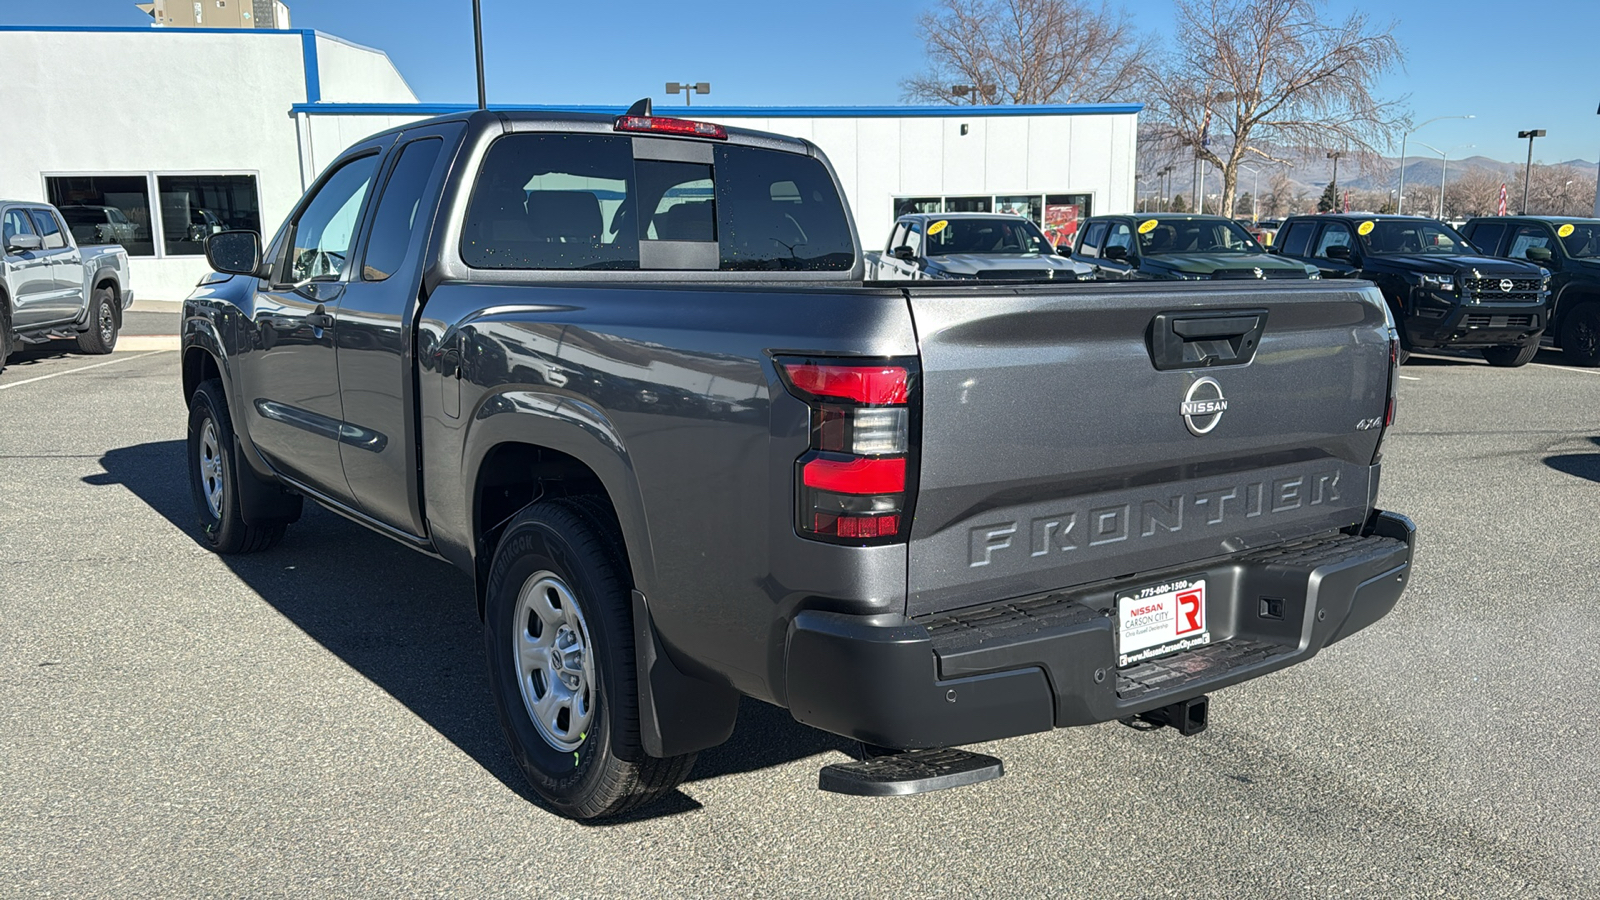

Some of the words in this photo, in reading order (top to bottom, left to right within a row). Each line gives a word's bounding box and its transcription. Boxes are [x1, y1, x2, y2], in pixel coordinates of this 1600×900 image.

[1183, 401, 1228, 413] NISSAN
[969, 470, 1342, 567] FRONTIER
[1141, 580, 1188, 598] 775-600-1500
[1130, 603, 1163, 617] NISSAN
[1178, 594, 1200, 630] R
[1125, 615, 1154, 629] CARSON
[1154, 611, 1169, 623] CITY
[1125, 629, 1136, 638] Chris
[1149, 623, 1169, 632] Dealership
[1127, 637, 1203, 663] www.NissanCarsonCity.com
